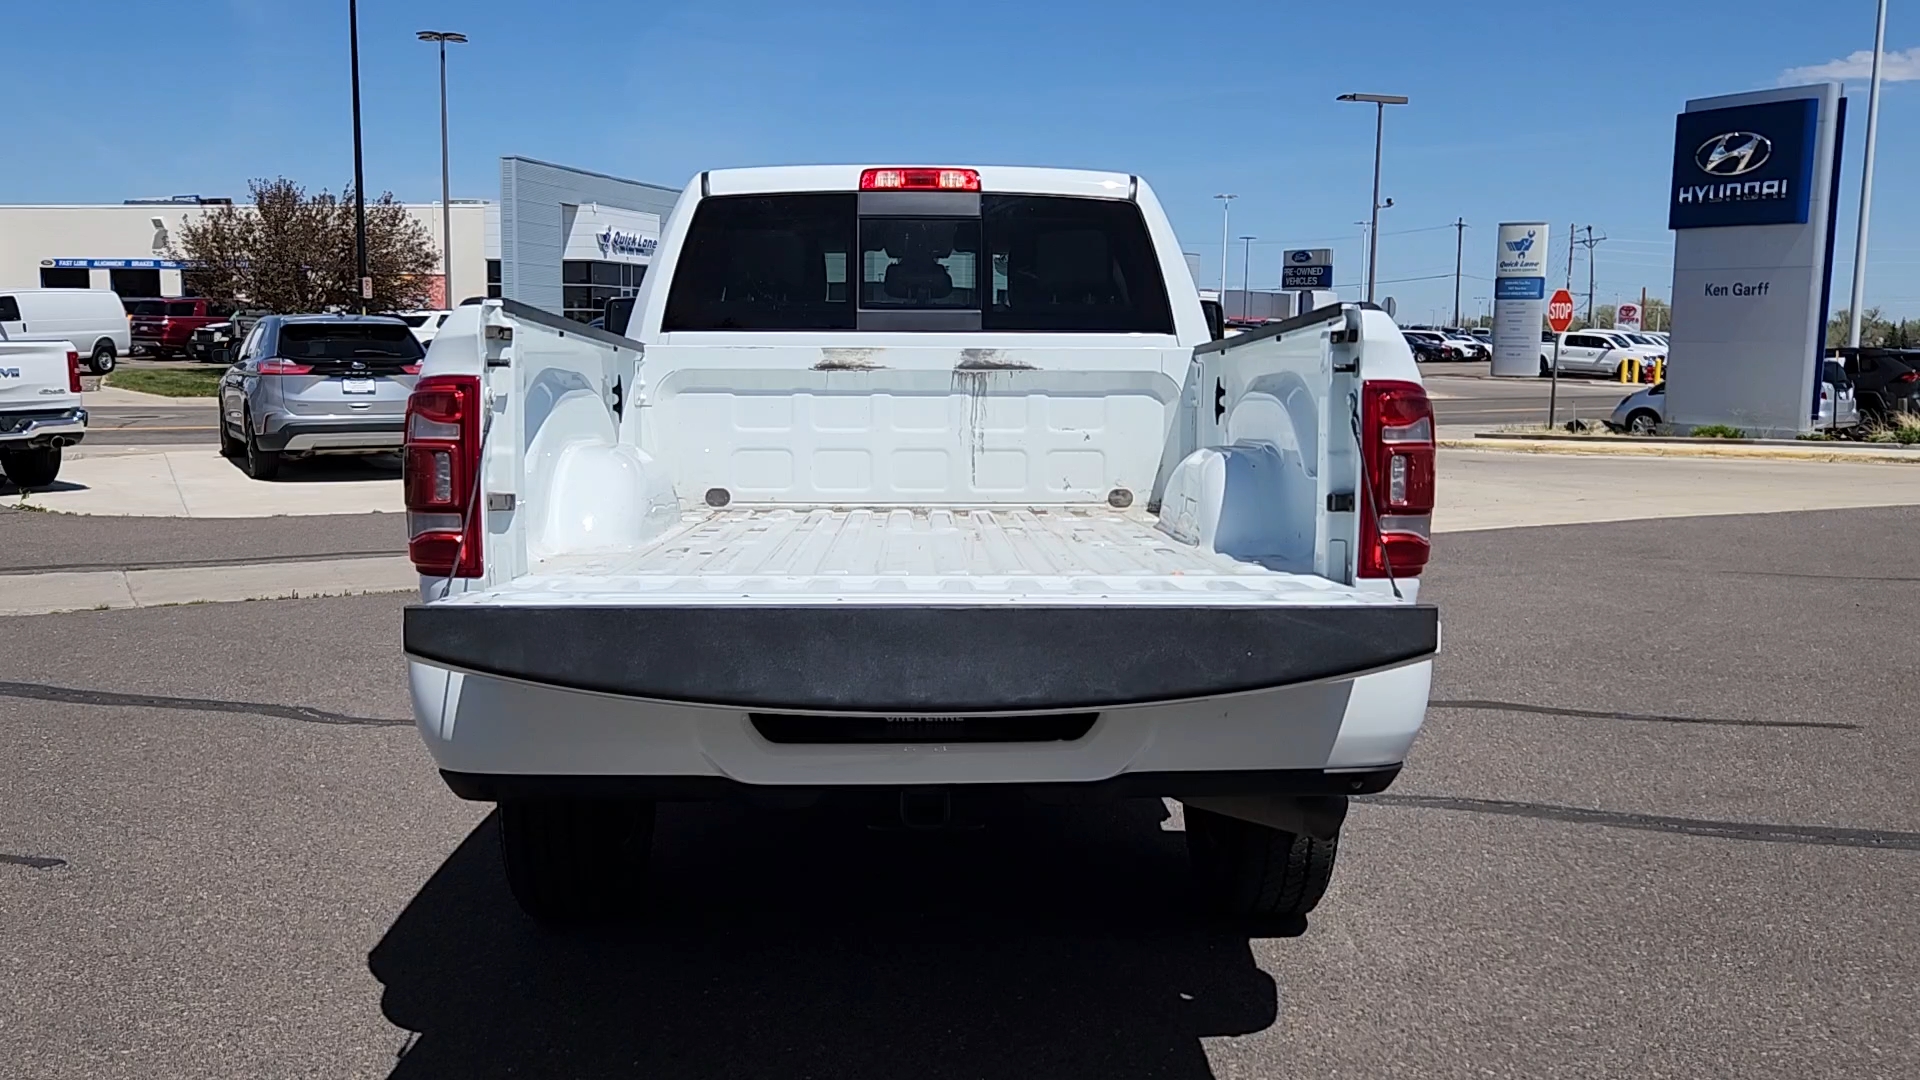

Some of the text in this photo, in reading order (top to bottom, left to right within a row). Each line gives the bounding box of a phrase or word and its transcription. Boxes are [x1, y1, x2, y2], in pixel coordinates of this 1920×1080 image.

[1678, 179, 1788, 204] HYUNDAI
[613, 231, 658, 249] Quick Lane
[1283, 267, 1324, 276] PRE-OWNED
[1500, 260, 1540, 268] Quick Lane
[1285, 276, 1318, 286] VEHICLES
[1704, 282, 1770, 297] Ken Garff
[1549, 302, 1572, 319] STOP
